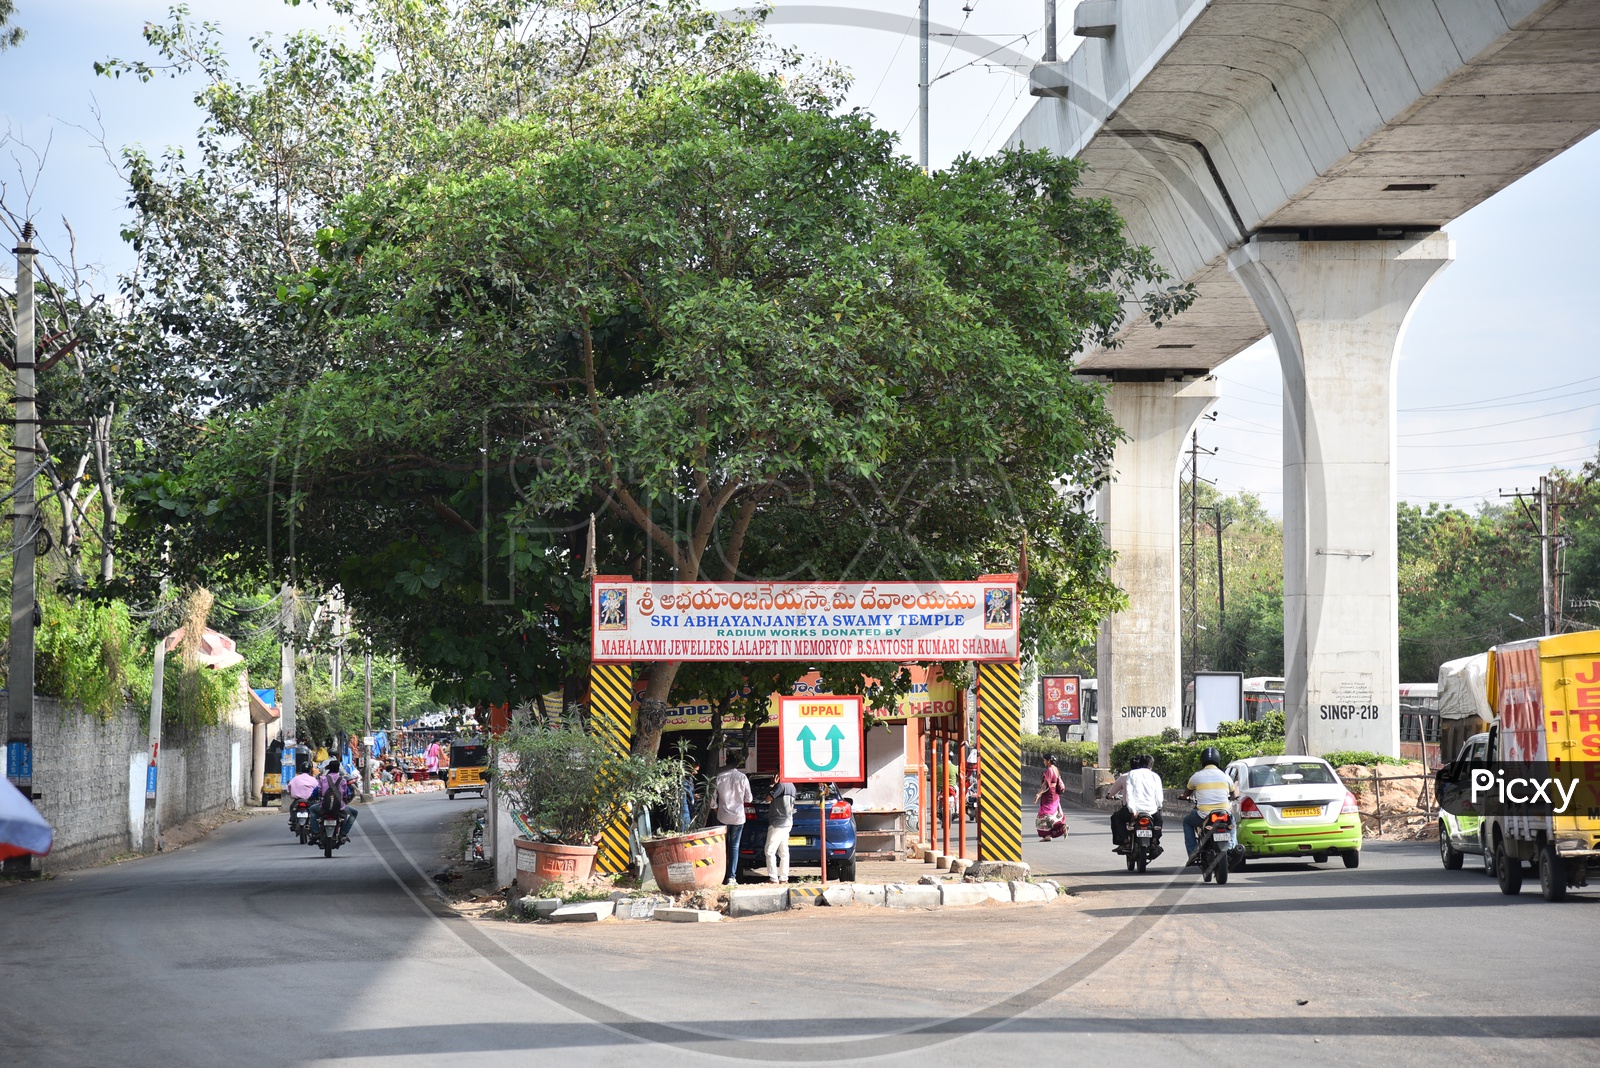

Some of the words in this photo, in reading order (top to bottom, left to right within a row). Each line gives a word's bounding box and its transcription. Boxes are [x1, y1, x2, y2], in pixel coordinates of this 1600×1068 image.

[636, 587, 655, 616] శ్రీ
[860, 586, 976, 610] దేవాలయము
[650, 615, 679, 627] SRI
[683, 614, 829, 627] ABHAYANJANEYA
[832, 614, 894, 627] SWAMY
[897, 614, 965, 626] TEMPLE
[717, 629, 767, 637] RADIUM
[770, 629, 817, 637] WORKS
[821, 628, 884, 637] DONATED
[885, 628, 902, 636] BY
[601, 639, 667, 656] MAHALAXMI
[668, 639, 729, 656] JEWELLERS
[732, 639, 779, 656] LALAPET
[781, 639, 792, 656] IN
[917, 639, 960, 655] KUMARI
[962, 638, 1008, 655] SHARMA
[801, 705, 841, 716] UPPAL
[910, 699, 955, 715] HERO
[1121, 706, 1167, 718] SINGP-20B
[1320, 705, 1379, 720] SINGP-21B
